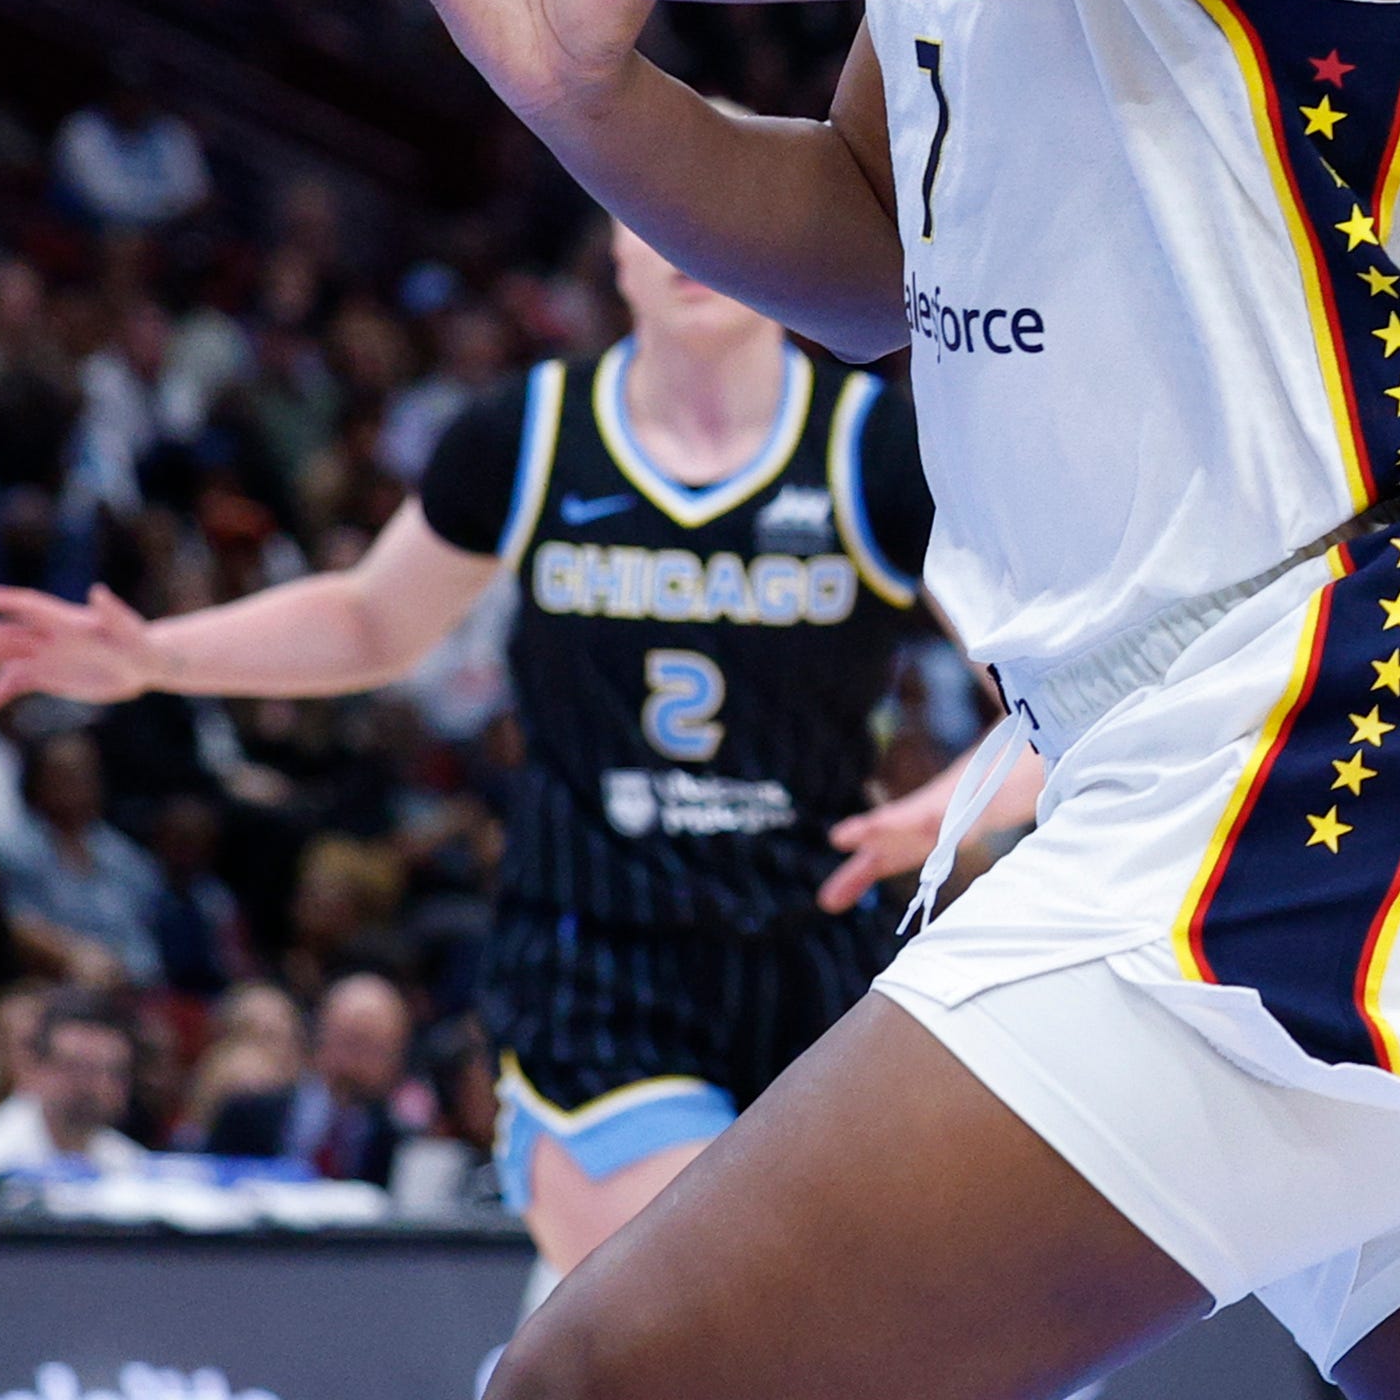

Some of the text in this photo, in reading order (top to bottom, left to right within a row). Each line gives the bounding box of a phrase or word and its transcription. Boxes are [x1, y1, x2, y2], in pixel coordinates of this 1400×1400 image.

[915, 36, 949, 244] 7
[532, 541, 858, 626] CHICAGO
[640, 649, 726, 762] 2
